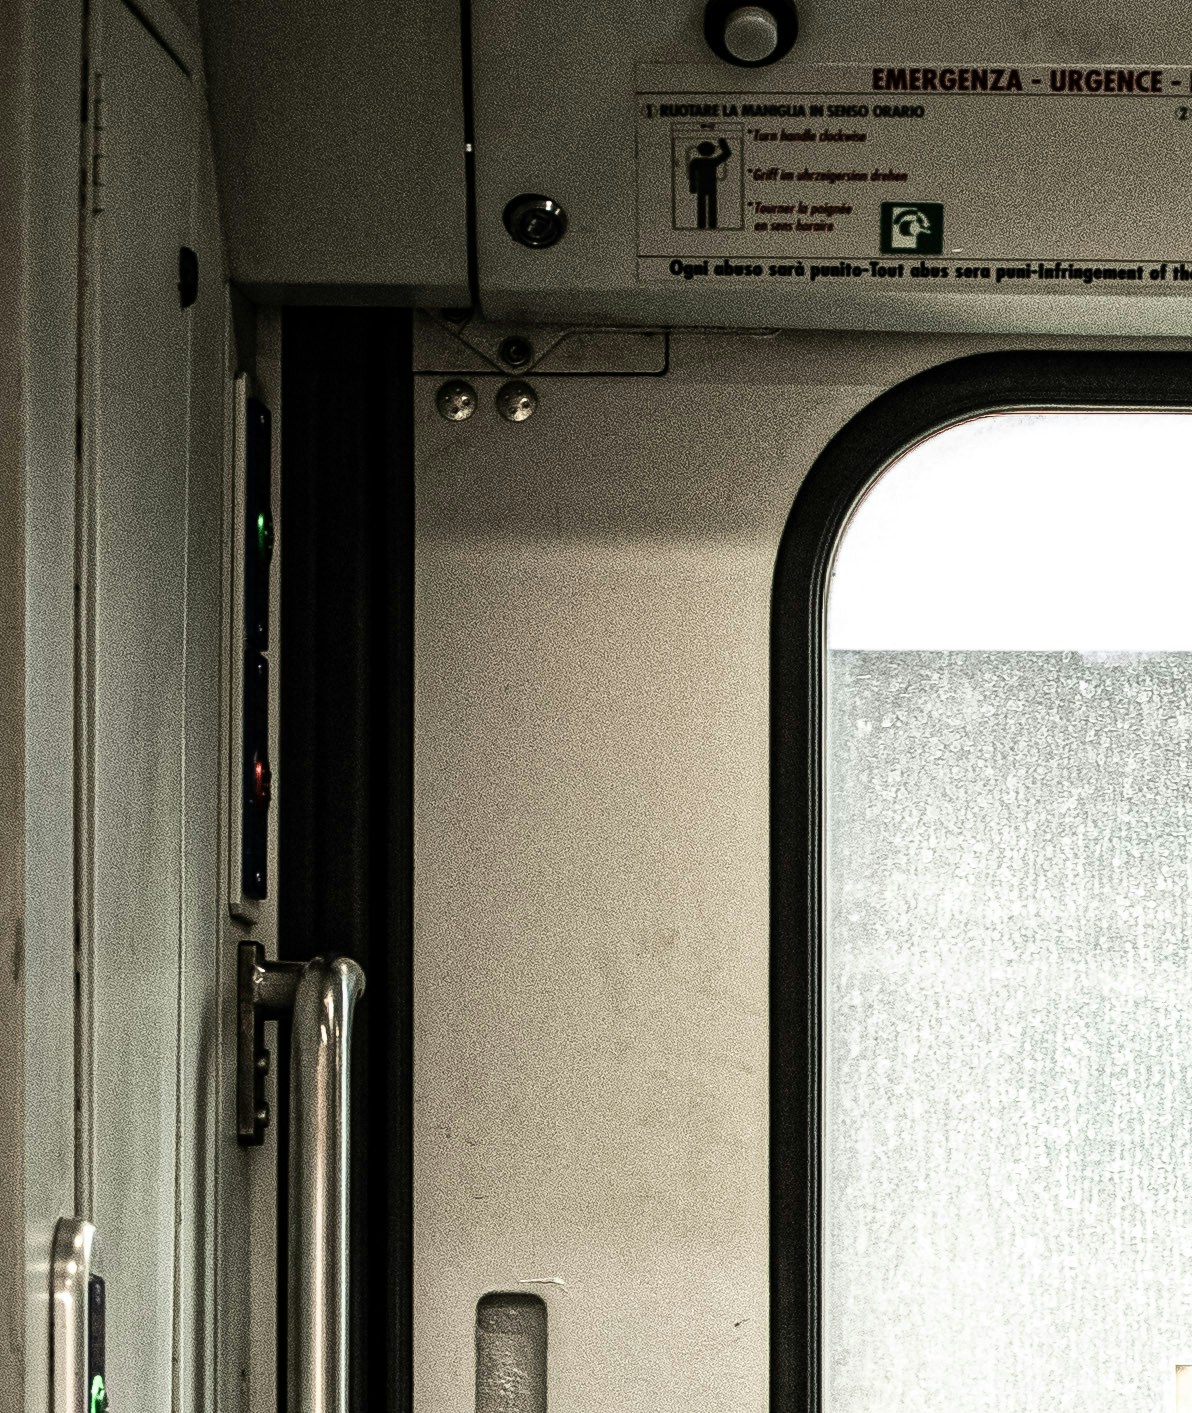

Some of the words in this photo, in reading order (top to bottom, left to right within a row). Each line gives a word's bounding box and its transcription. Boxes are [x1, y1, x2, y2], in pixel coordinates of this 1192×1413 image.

[871, 68, 1023, 91] EMERGENZA
[1049, 69, 1163, 92] URGENCE
[659, 102, 719, 118] RUOTARE
[722, 103, 738, 117] LA
[741, 103, 806, 117] MANIGLIA
[809, 104, 824, 117] IN
[827, 104, 869, 117] SENSO
[873, 104, 925, 118] ORARIO
[668, 260, 710, 280] Ogni
[713, 260, 764, 276] abuso
[768, 260, 806, 277] sarà
[909, 261, 949, 278] abus
[955, 266, 991, 278] sera
[1149, 263, 1167, 280] of
